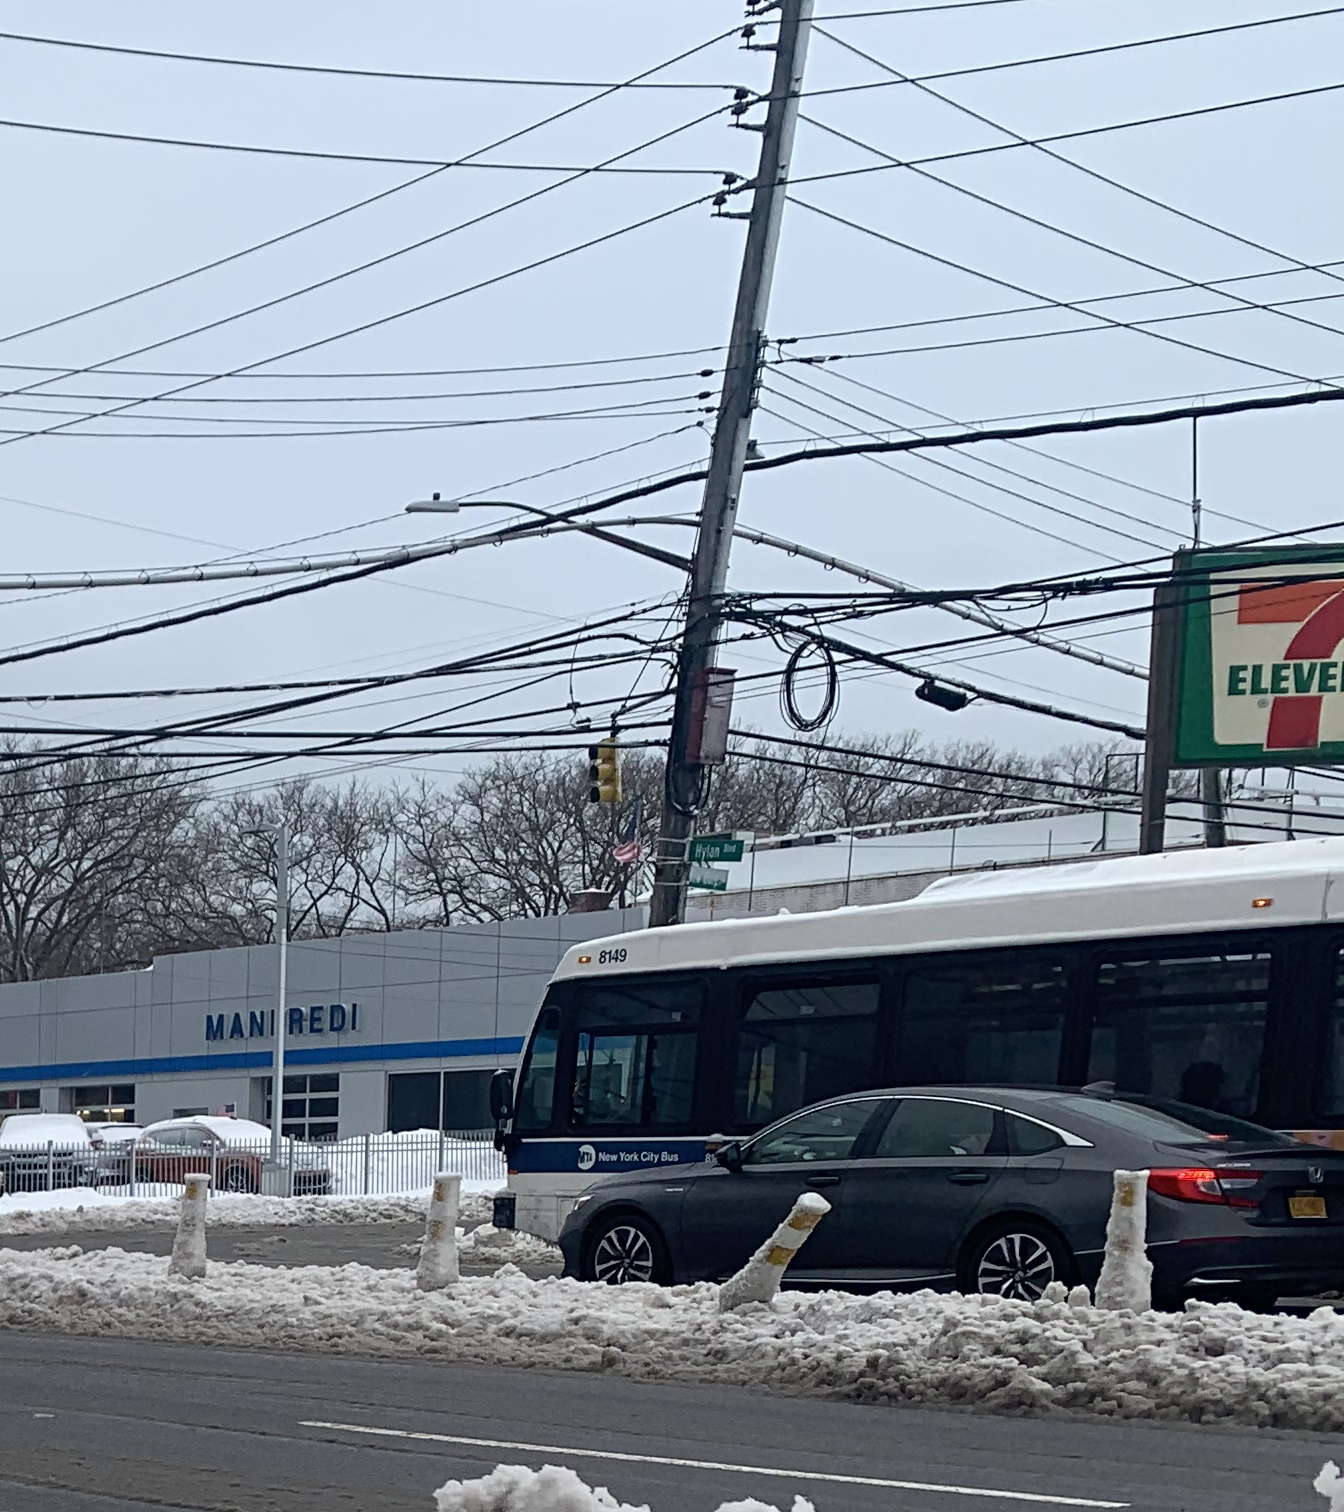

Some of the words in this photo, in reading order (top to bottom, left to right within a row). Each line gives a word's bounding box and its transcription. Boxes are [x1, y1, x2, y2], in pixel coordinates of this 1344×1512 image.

[1228, 661, 1344, 696] ELEVE
[695, 843, 721, 861] Hylan
[598, 948, 627, 964] 8149
[598, 1152, 618, 1163] New
[619, 1151, 640, 1163] York
[640, 1151, 660, 1164] City
[661, 1151, 680, 1163] Bus
